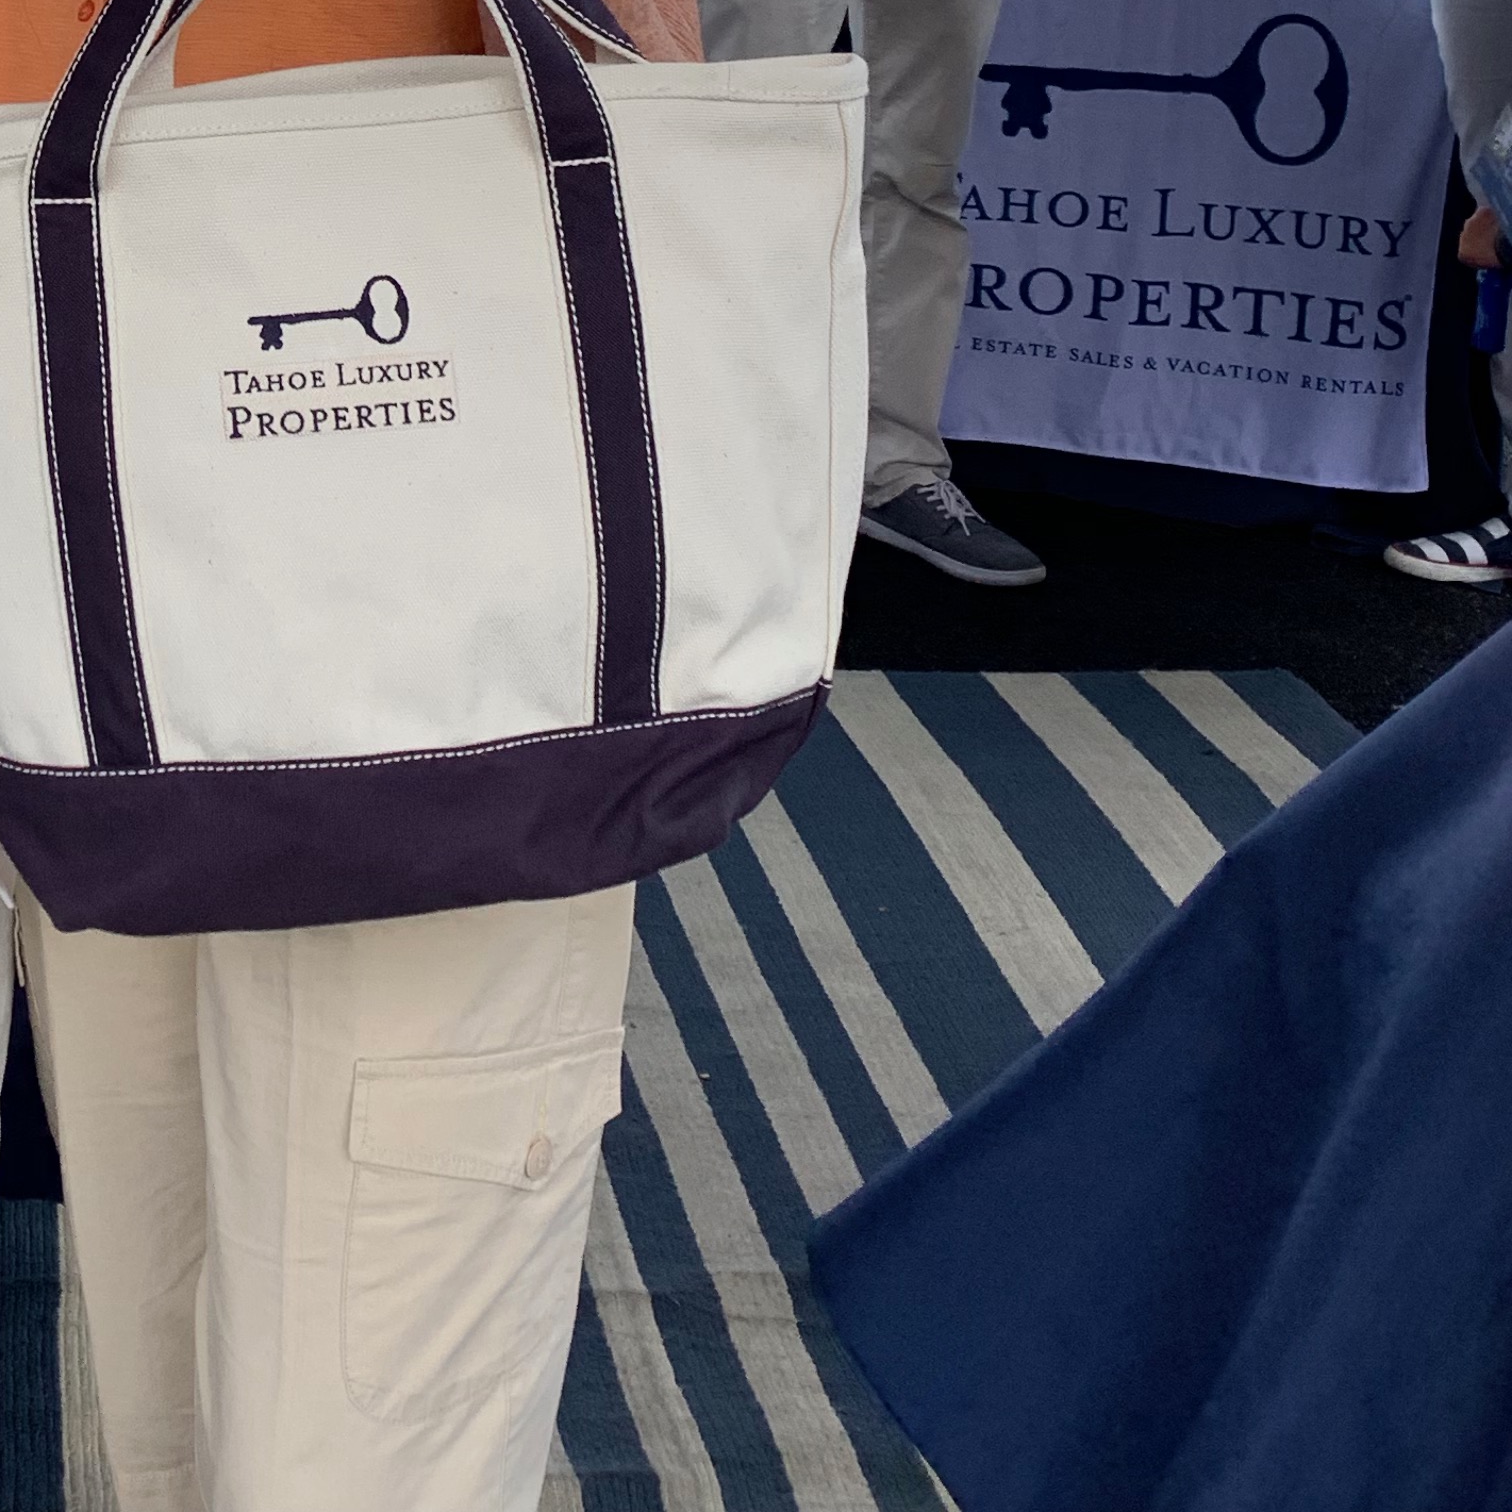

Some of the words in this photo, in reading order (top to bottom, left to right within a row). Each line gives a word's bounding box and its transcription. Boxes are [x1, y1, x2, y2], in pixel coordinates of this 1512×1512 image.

[957, 178, 1129, 232] AHOE
[1151, 188, 1413, 258] LUXURY
[964, 263, 1408, 352] ROPERTIES
[224, 369, 326, 396] TAHOE
[335, 359, 450, 388] LUXURY
[972, 337, 1058, 360] ESTATE
[1069, 347, 1134, 370] SALES
[1143, 356, 1158, 371] &
[1167, 357, 1290, 385] VACATION
[1301, 373, 1406, 398] RENTALS
[227, 397, 457, 440] PROPERTIES
